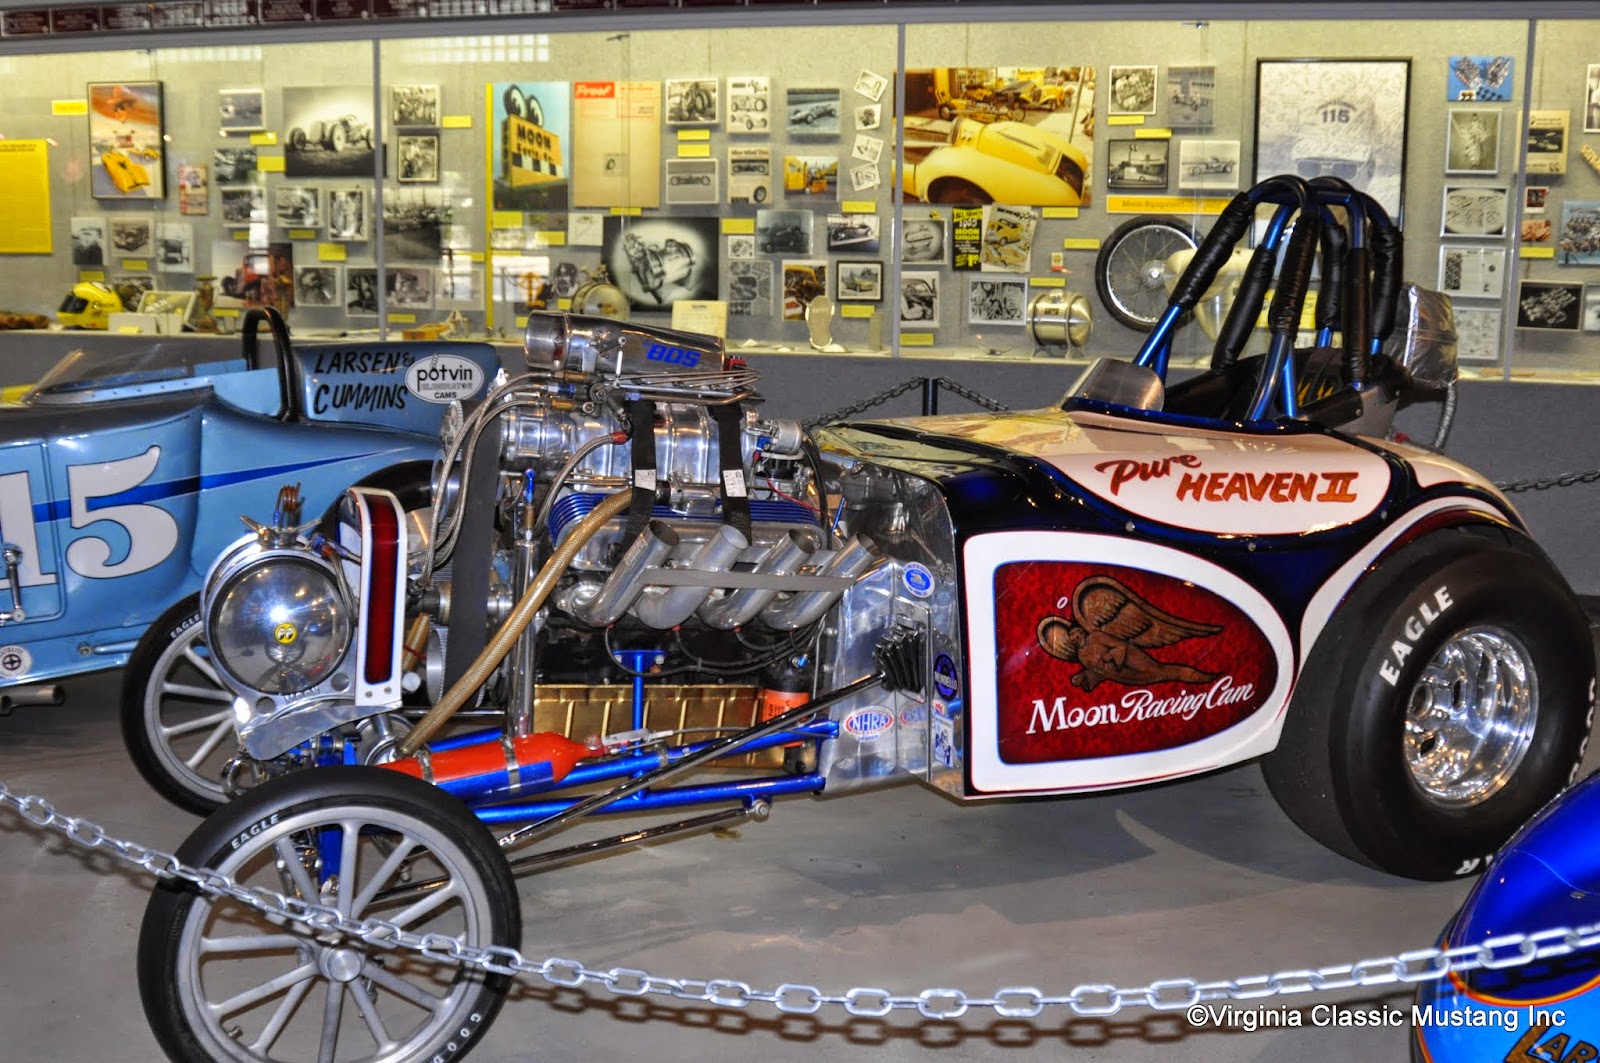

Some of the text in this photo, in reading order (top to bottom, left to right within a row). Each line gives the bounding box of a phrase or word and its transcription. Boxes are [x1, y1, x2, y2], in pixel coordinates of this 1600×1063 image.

[575, 84, 612, 97] Proof
[516, 122, 551, 151] MOON
[314, 352, 400, 375] LARSEN
[417, 363, 473, 392] potvin
[313, 382, 408, 415] CUMMINS
[434, 391, 457, 399] CAMS
[1176, 472, 1359, 503] HEAVEN II
[170, 613, 200, 639] EAGLE
[1379, 586, 1454, 686] EAGLE
[285, 686, 320, 702] MOON
[1026, 676, 1255, 734] Moon Racing Cam
[852, 712, 888, 732] NHRA
[231, 814, 279, 850] EAGLE
